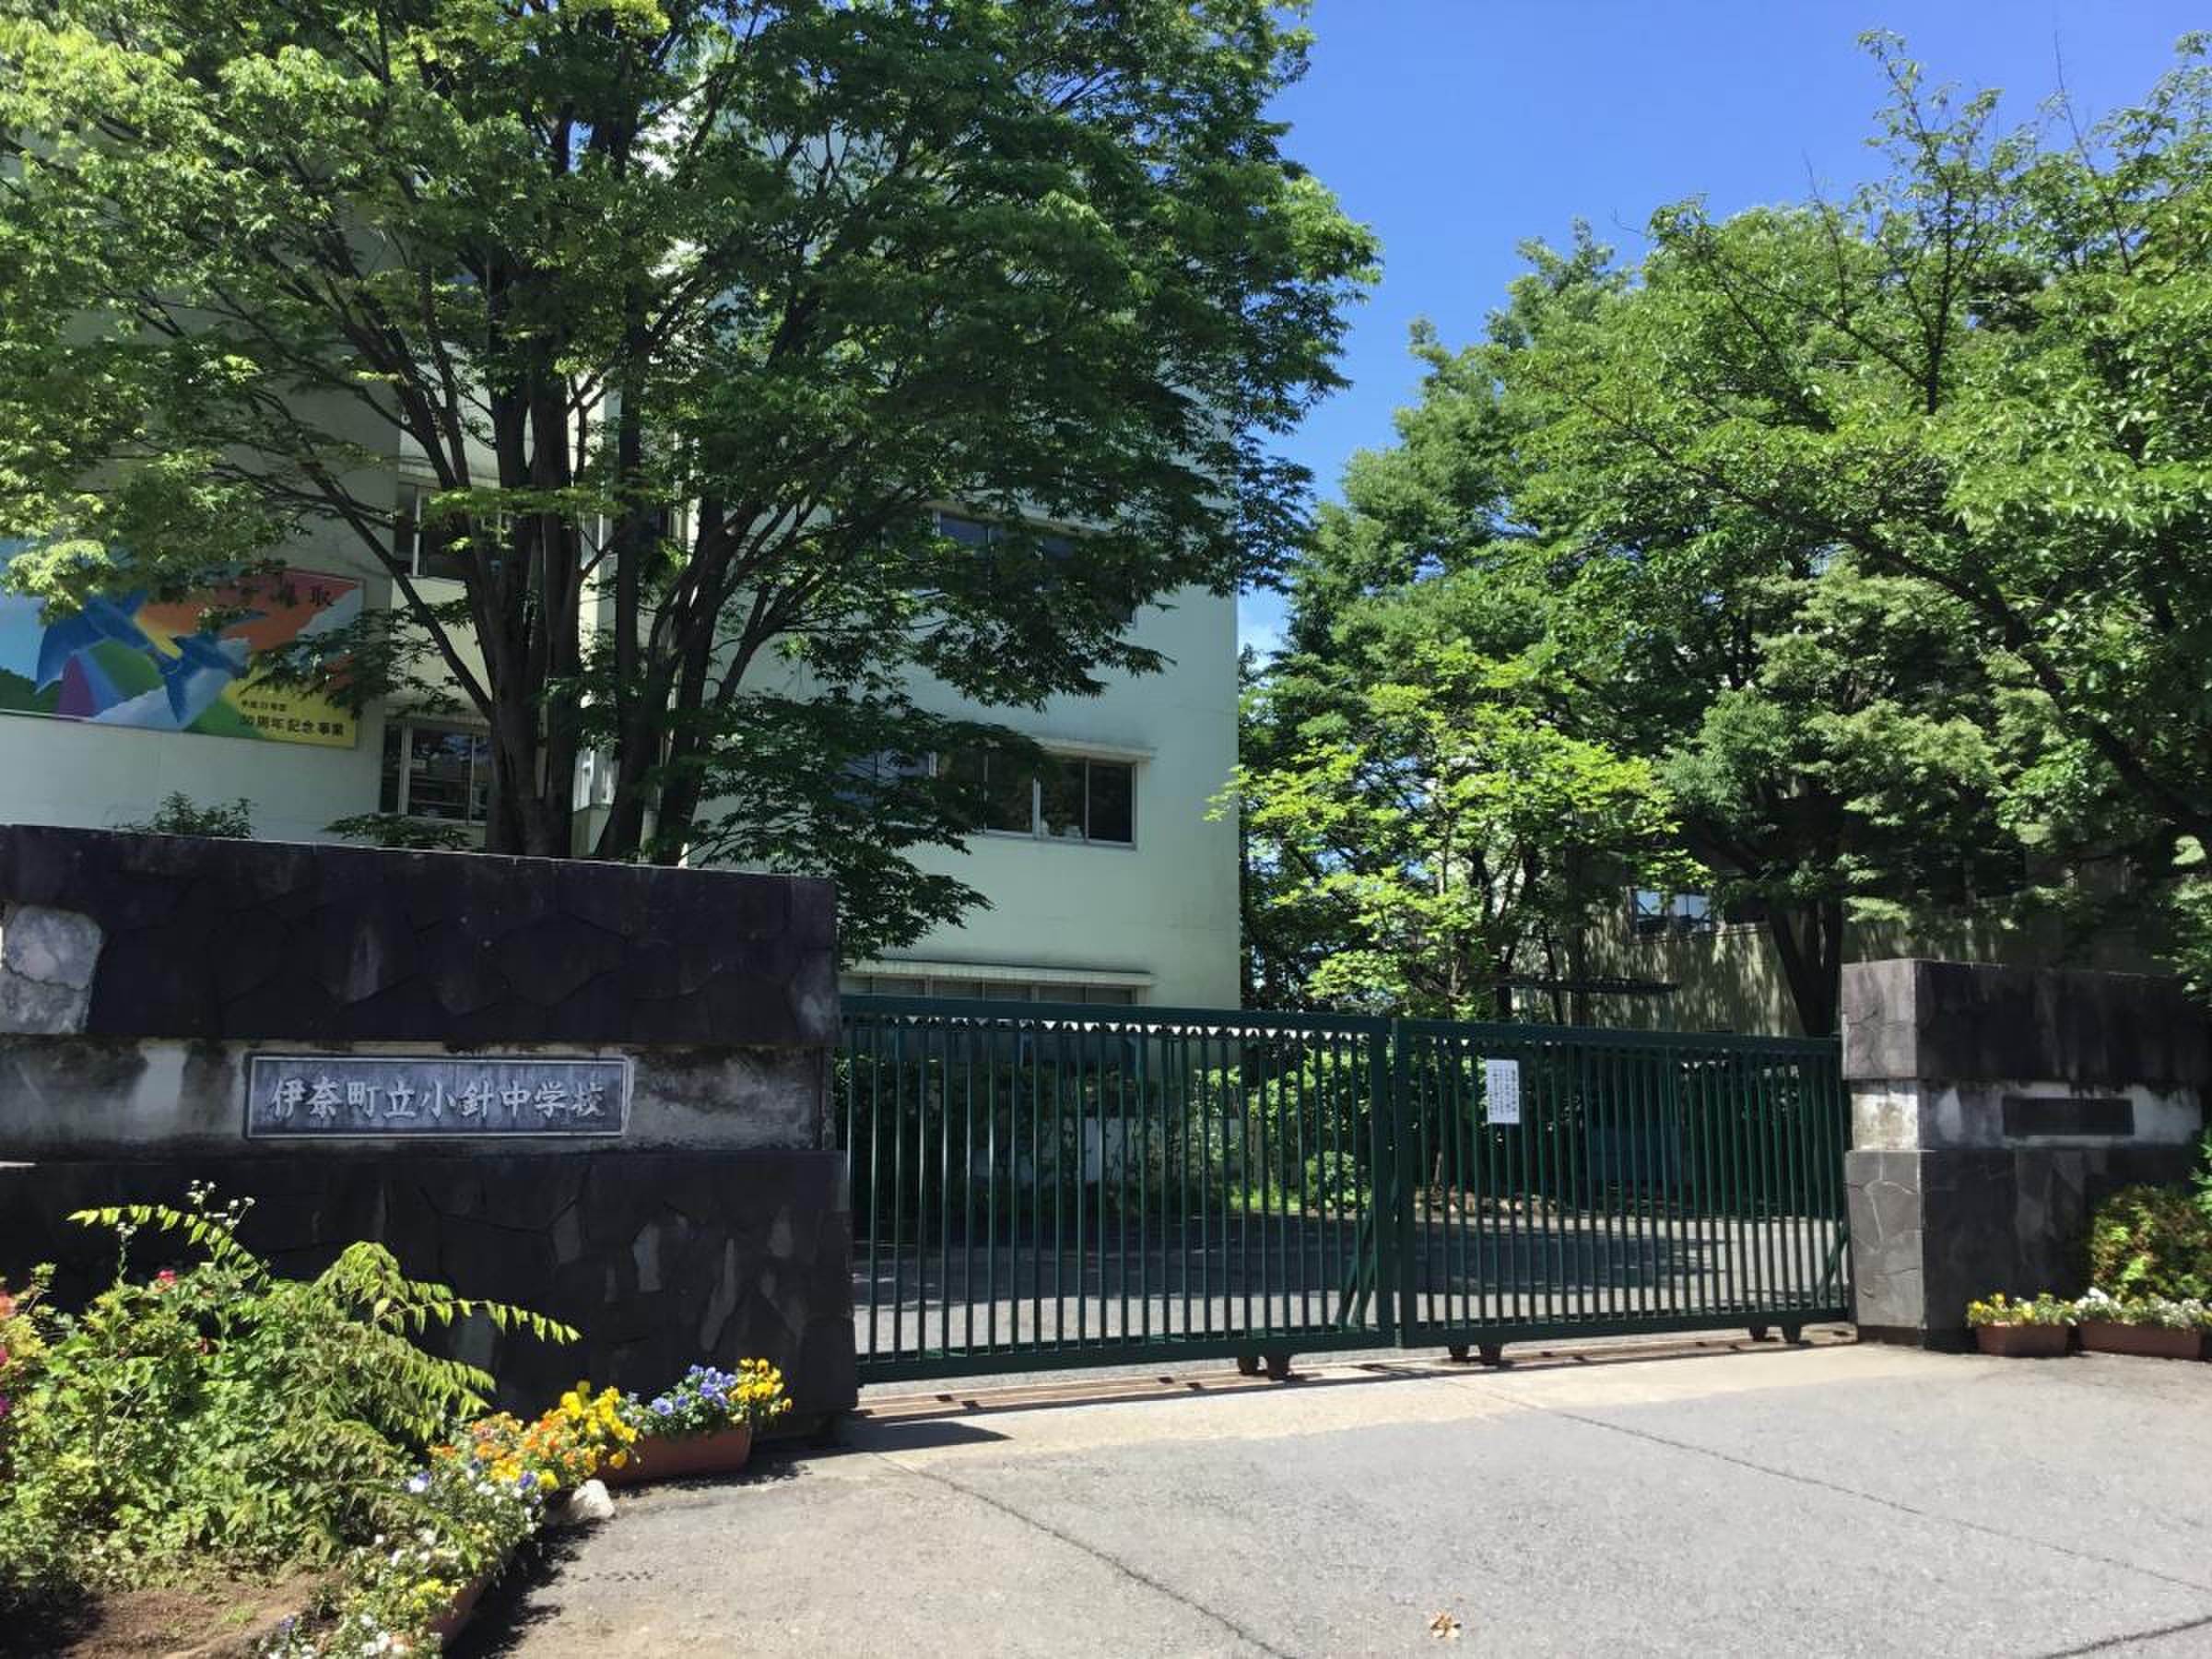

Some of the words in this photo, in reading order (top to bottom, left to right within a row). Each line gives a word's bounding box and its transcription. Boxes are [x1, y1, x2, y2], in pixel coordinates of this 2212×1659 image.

[269, 1075, 606, 1120] 伊奈町立小針中学校
